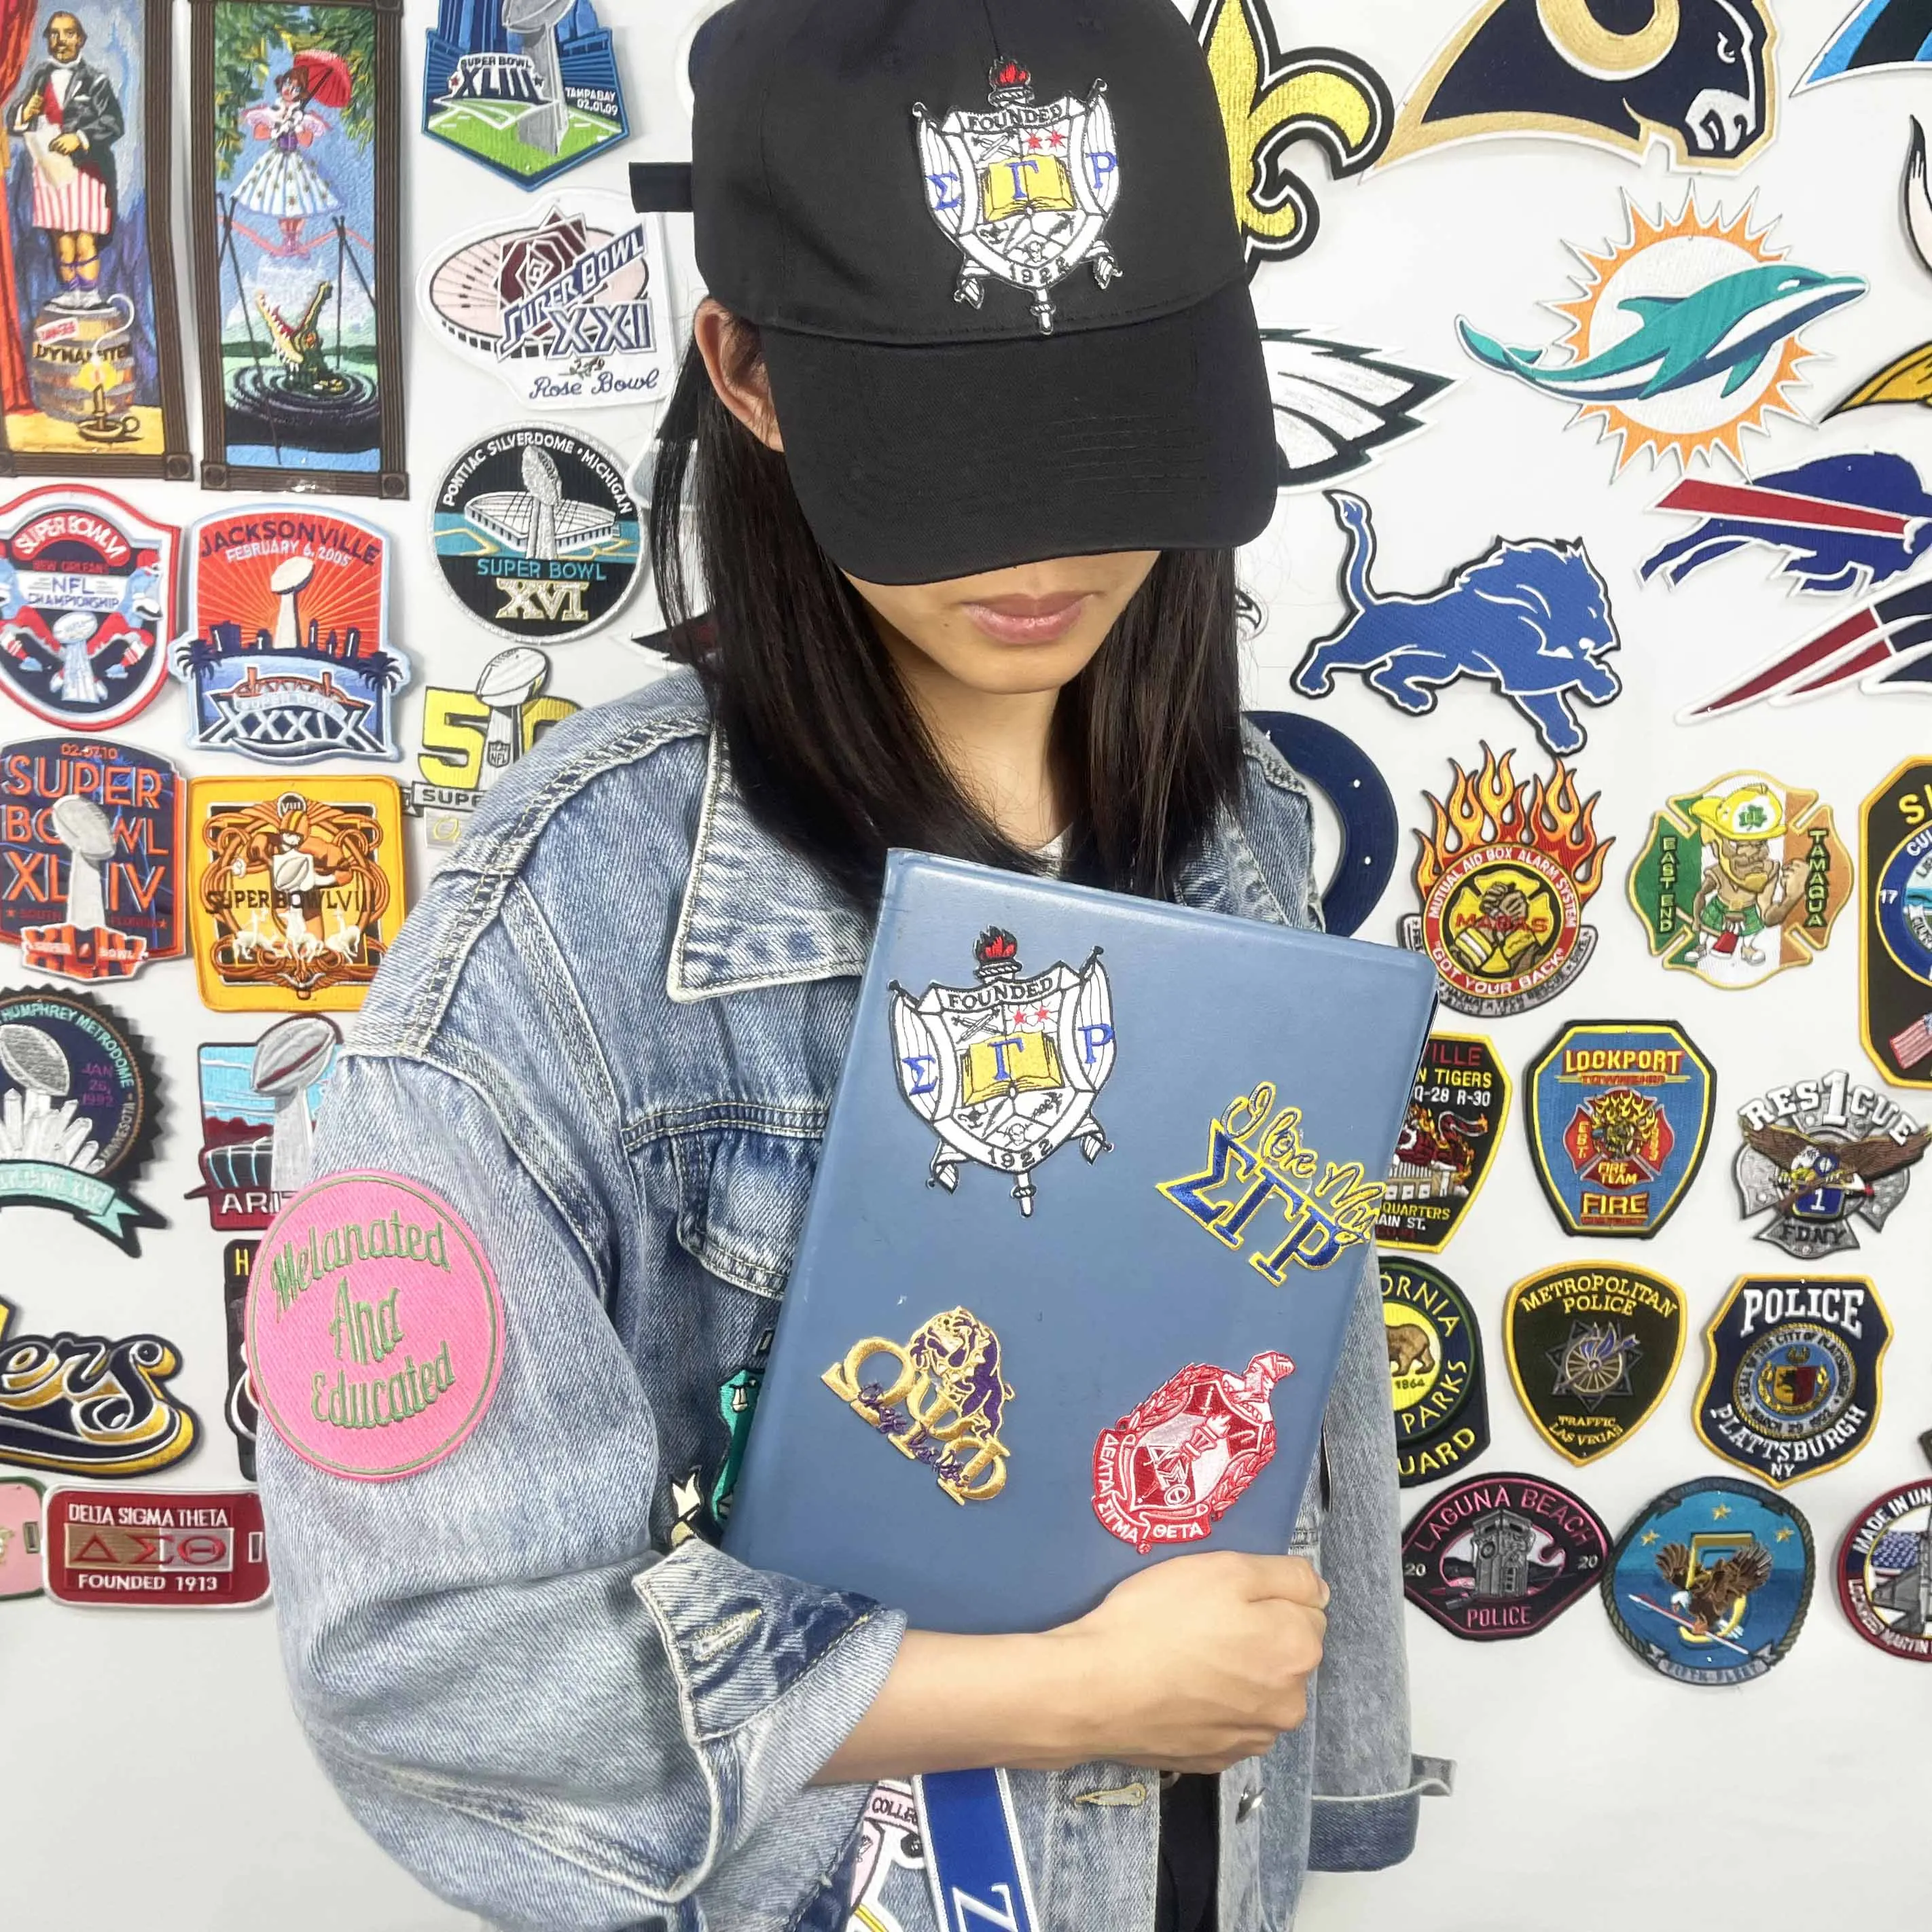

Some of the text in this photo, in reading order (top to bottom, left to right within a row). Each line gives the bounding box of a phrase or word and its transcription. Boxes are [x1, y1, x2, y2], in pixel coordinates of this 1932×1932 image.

[461, 56, 533, 69] SUPER BOWL
[453, 67, 540, 101] XLIII
[968, 103, 1064, 131] FOUNDED
[1009, 255, 1071, 284] 1922
[498, 227, 645, 361] SUPER BOWL
[546, 301, 656, 359] XXI
[37, 344, 127, 363] DYNATE
[529, 368, 660, 399] Rose Bowl
[443, 432, 632, 514] PONTIAC SILVERDOME MICHIGAN
[15, 516, 65, 554] SUPER
[201, 520, 380, 565] JACKSONVILLE
[226, 539, 298, 563] FEBRUARY
[317, 545, 352, 567] 2005
[478, 558, 606, 580] SUPER BOWL
[52, 577, 94, 594] NFL
[28, 592, 119, 609] CHAMPIONSHIP
[495, 577, 590, 622] XVI
[242, 692, 340, 713] SUPER BOWL
[490, 752, 508, 764] NFL
[3, 755, 162, 809] SUPER
[1429, 846, 1577, 928] MUTUAL AID BOX ALARM SYSTEM
[1808, 829, 1829, 927] TAMAQUA
[205, 890, 270, 914] SUPER
[1880, 889, 1898, 904] 17
[1455, 913, 1549, 933] MABAS
[1660, 894, 1676, 933] END
[949, 976, 1054, 1009] FOUNDED
[1465, 976, 1513, 995] YOUR
[1, 1003, 135, 1088] HUMPHREY METRODOME
[82, 1063, 114, 1079] JAN
[1564, 1050, 1685, 1075] LOCKPORT
[1434, 1068, 1492, 1088] TIGERS
[82, 1093, 115, 1108] 1992
[1457, 1089, 1491, 1107] R-30
[988, 1138, 1054, 1168] 1922
[1598, 1162, 1629, 1175] FIRE
[1601, 1173, 1639, 1185] TEAM
[1380, 1201, 1451, 1221] QUARTERS
[1583, 1192, 1649, 1215] FIRE
[1810, 1188, 1826, 1211] 1
[1406, 1217, 1427, 1231] ST.
[1780, 1226, 1847, 1245] FDNY
[271, 1209, 451, 1323] Melanated
[1380, 1274, 1461, 1338] ORNIA
[1519, 1274, 1678, 1318] METROPOLITAN
[1563, 1294, 1637, 1317] POLICE
[329, 1276, 405, 1365] And
[1740, 1287, 1865, 1340] POLICE
[311, 1340, 456, 1429] Educated
[1395, 1380, 1426, 1390] 1864
[1401, 1359, 1468, 1434] PARKS
[1558, 1415, 1616, 1427] TRAFFIC
[1710, 1403, 1867, 1463] PLATTSBURGH
[1549, 1423, 1624, 1447] LAS VEGAS
[1397, 1427, 1476, 1475] UARD
[1770, 1463, 1795, 1478] NY
[69, 1503, 228, 1528] DELTA SIGMA THETA
[1888, 1495, 1909, 1517] IN
[1415, 1486, 1511, 1552] LAGUNA
[1521, 1488, 1596, 1547] BEACH
[1404, 1563, 1427, 1577] 20
[1577, 1554, 1598, 1570] 20
[78, 1573, 219, 1592] FOUNDED 1913
[1467, 1605, 1533, 1628] POLICE
